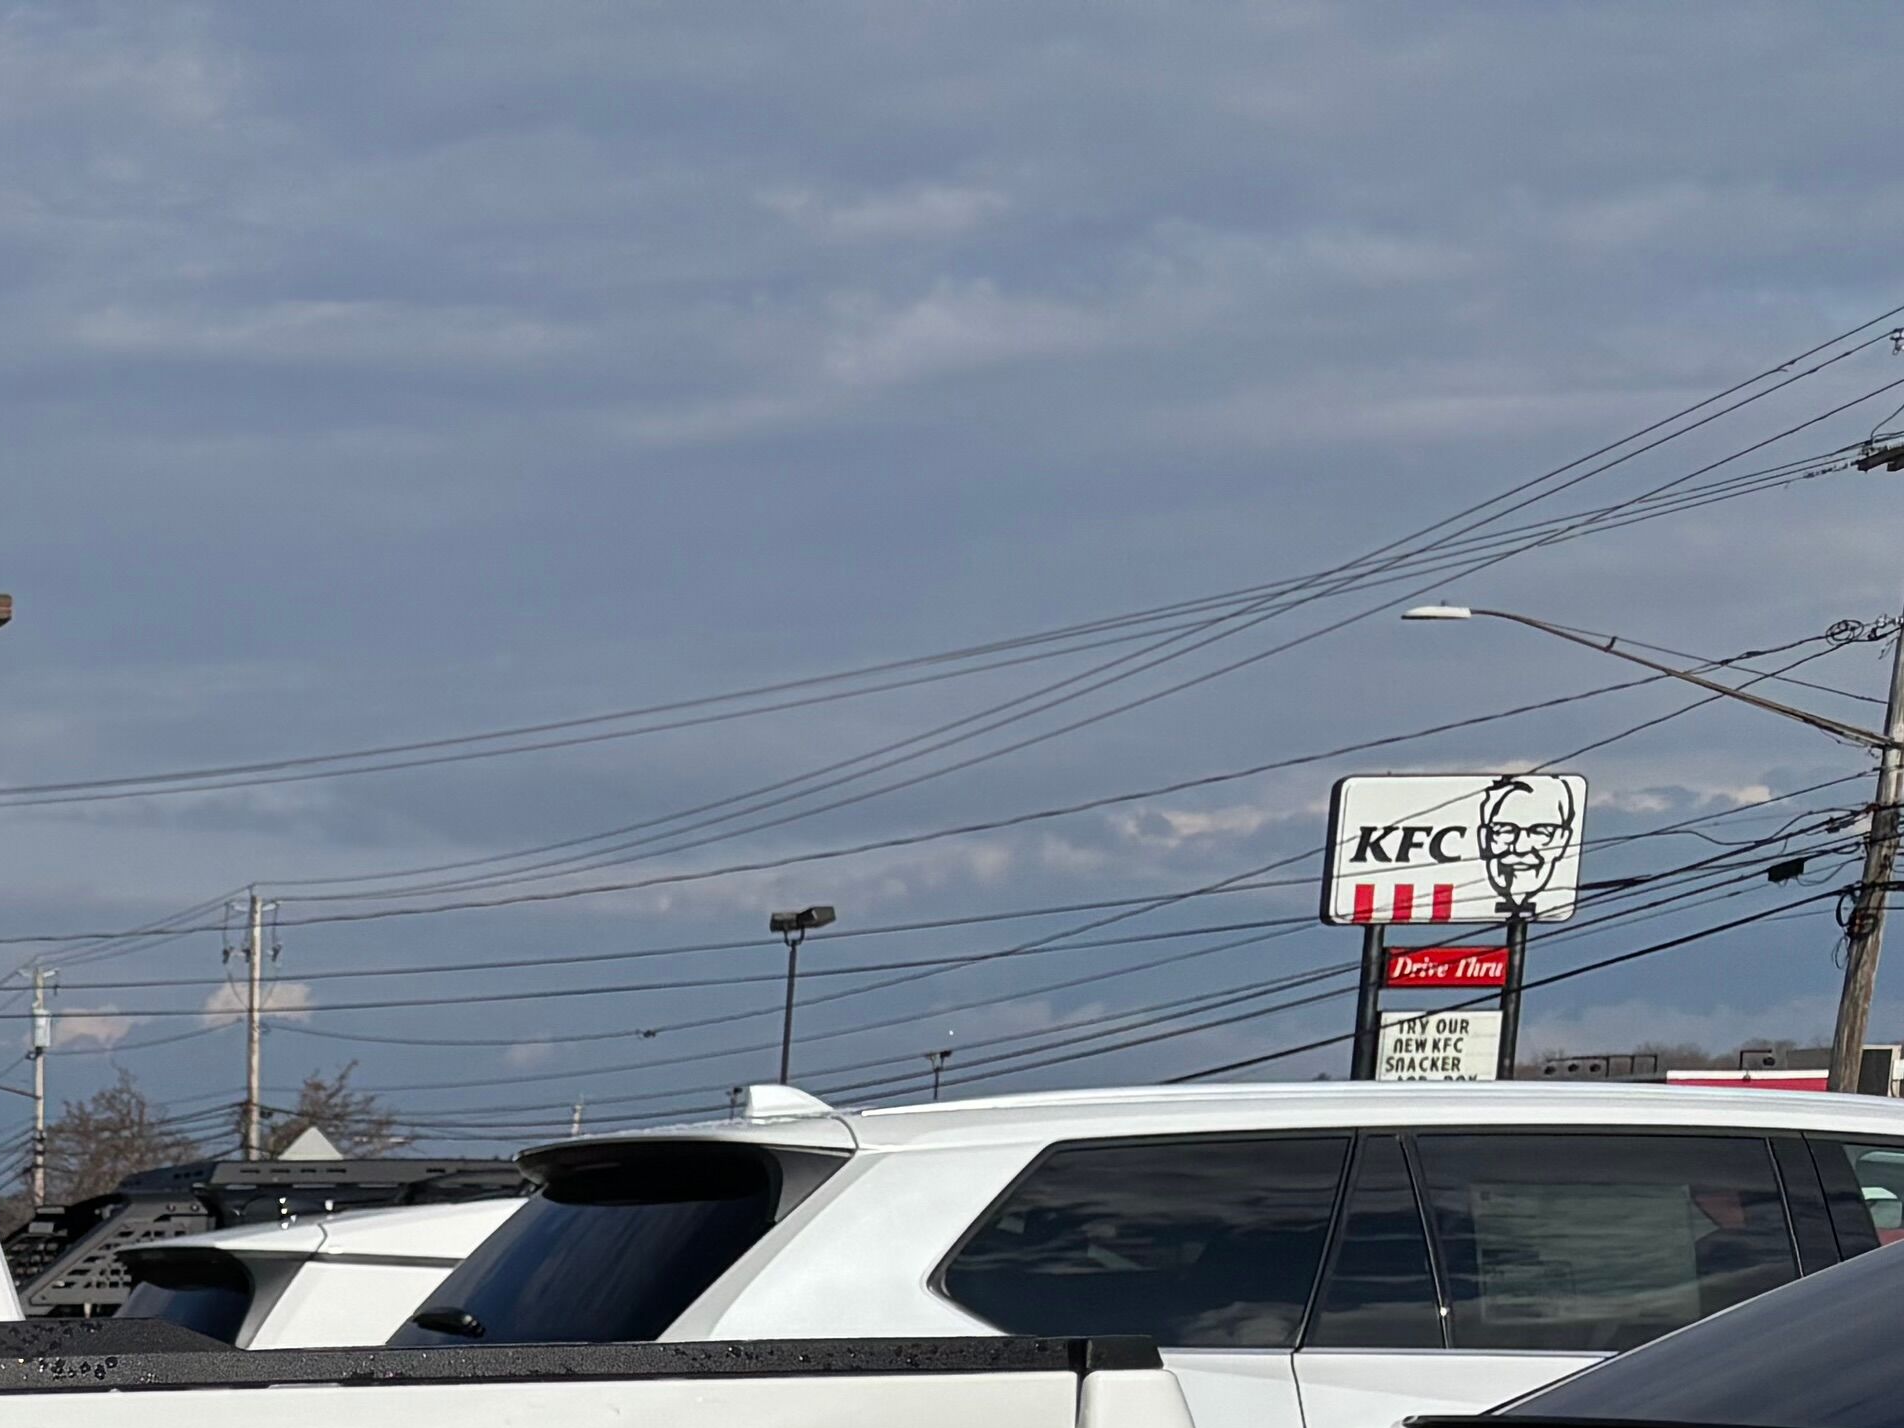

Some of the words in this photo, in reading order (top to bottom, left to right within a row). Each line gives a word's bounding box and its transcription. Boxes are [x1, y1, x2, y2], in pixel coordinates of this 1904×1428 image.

[1349, 825, 1467, 863] KFC
[1392, 956, 1449, 978] Drive
[1454, 956, 1504, 978] Thru
[1398, 1017, 1429, 1035] TRY
[1436, 1018, 1469, 1035] OUR
[1393, 1037, 1427, 1054] NEW
[1431, 1037, 1464, 1053] KFC
[1385, 1055, 1461, 1073] SNACKER
